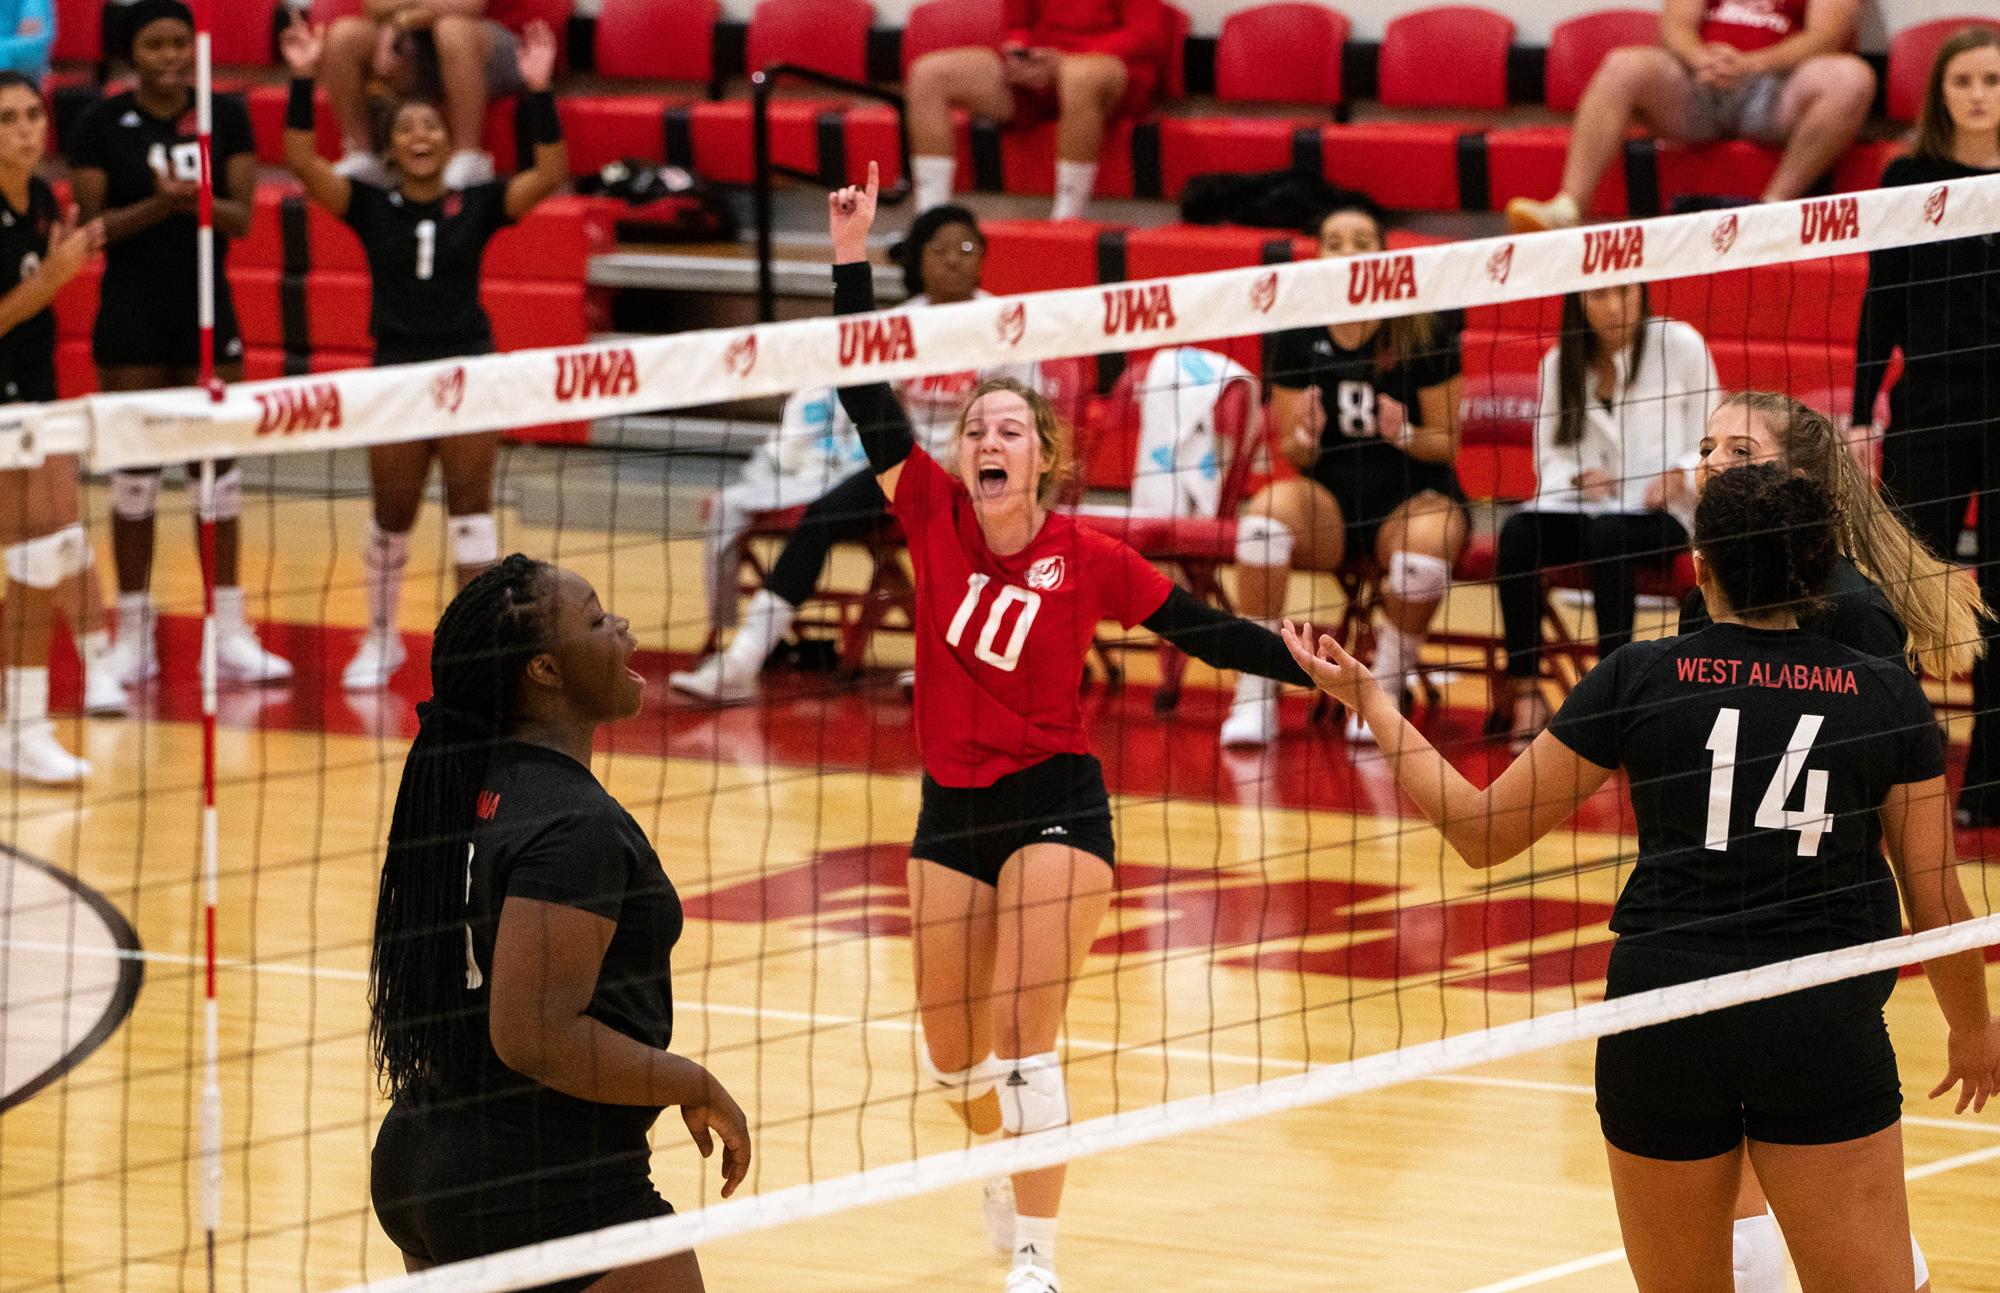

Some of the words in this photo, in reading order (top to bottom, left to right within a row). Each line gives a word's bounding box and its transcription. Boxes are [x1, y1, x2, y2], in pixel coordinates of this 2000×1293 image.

[1800, 197, 1860, 245] UWA
[415, 219, 436, 280] 1
[1581, 226, 1645, 275] UWA
[1347, 255, 1418, 305] UWA
[1102, 283, 1177, 336] UWA
[838, 315, 918, 368] UWA
[554, 349, 641, 403] UWA
[254, 382, 343, 438] UWA
[1337, 380, 1375, 437] 8
[945, 572, 1041, 672] 10
[1677, 657, 1742, 685] WEST
[1749, 661, 1859, 695] ALABAMA
[1704, 707, 1834, 857] 14
